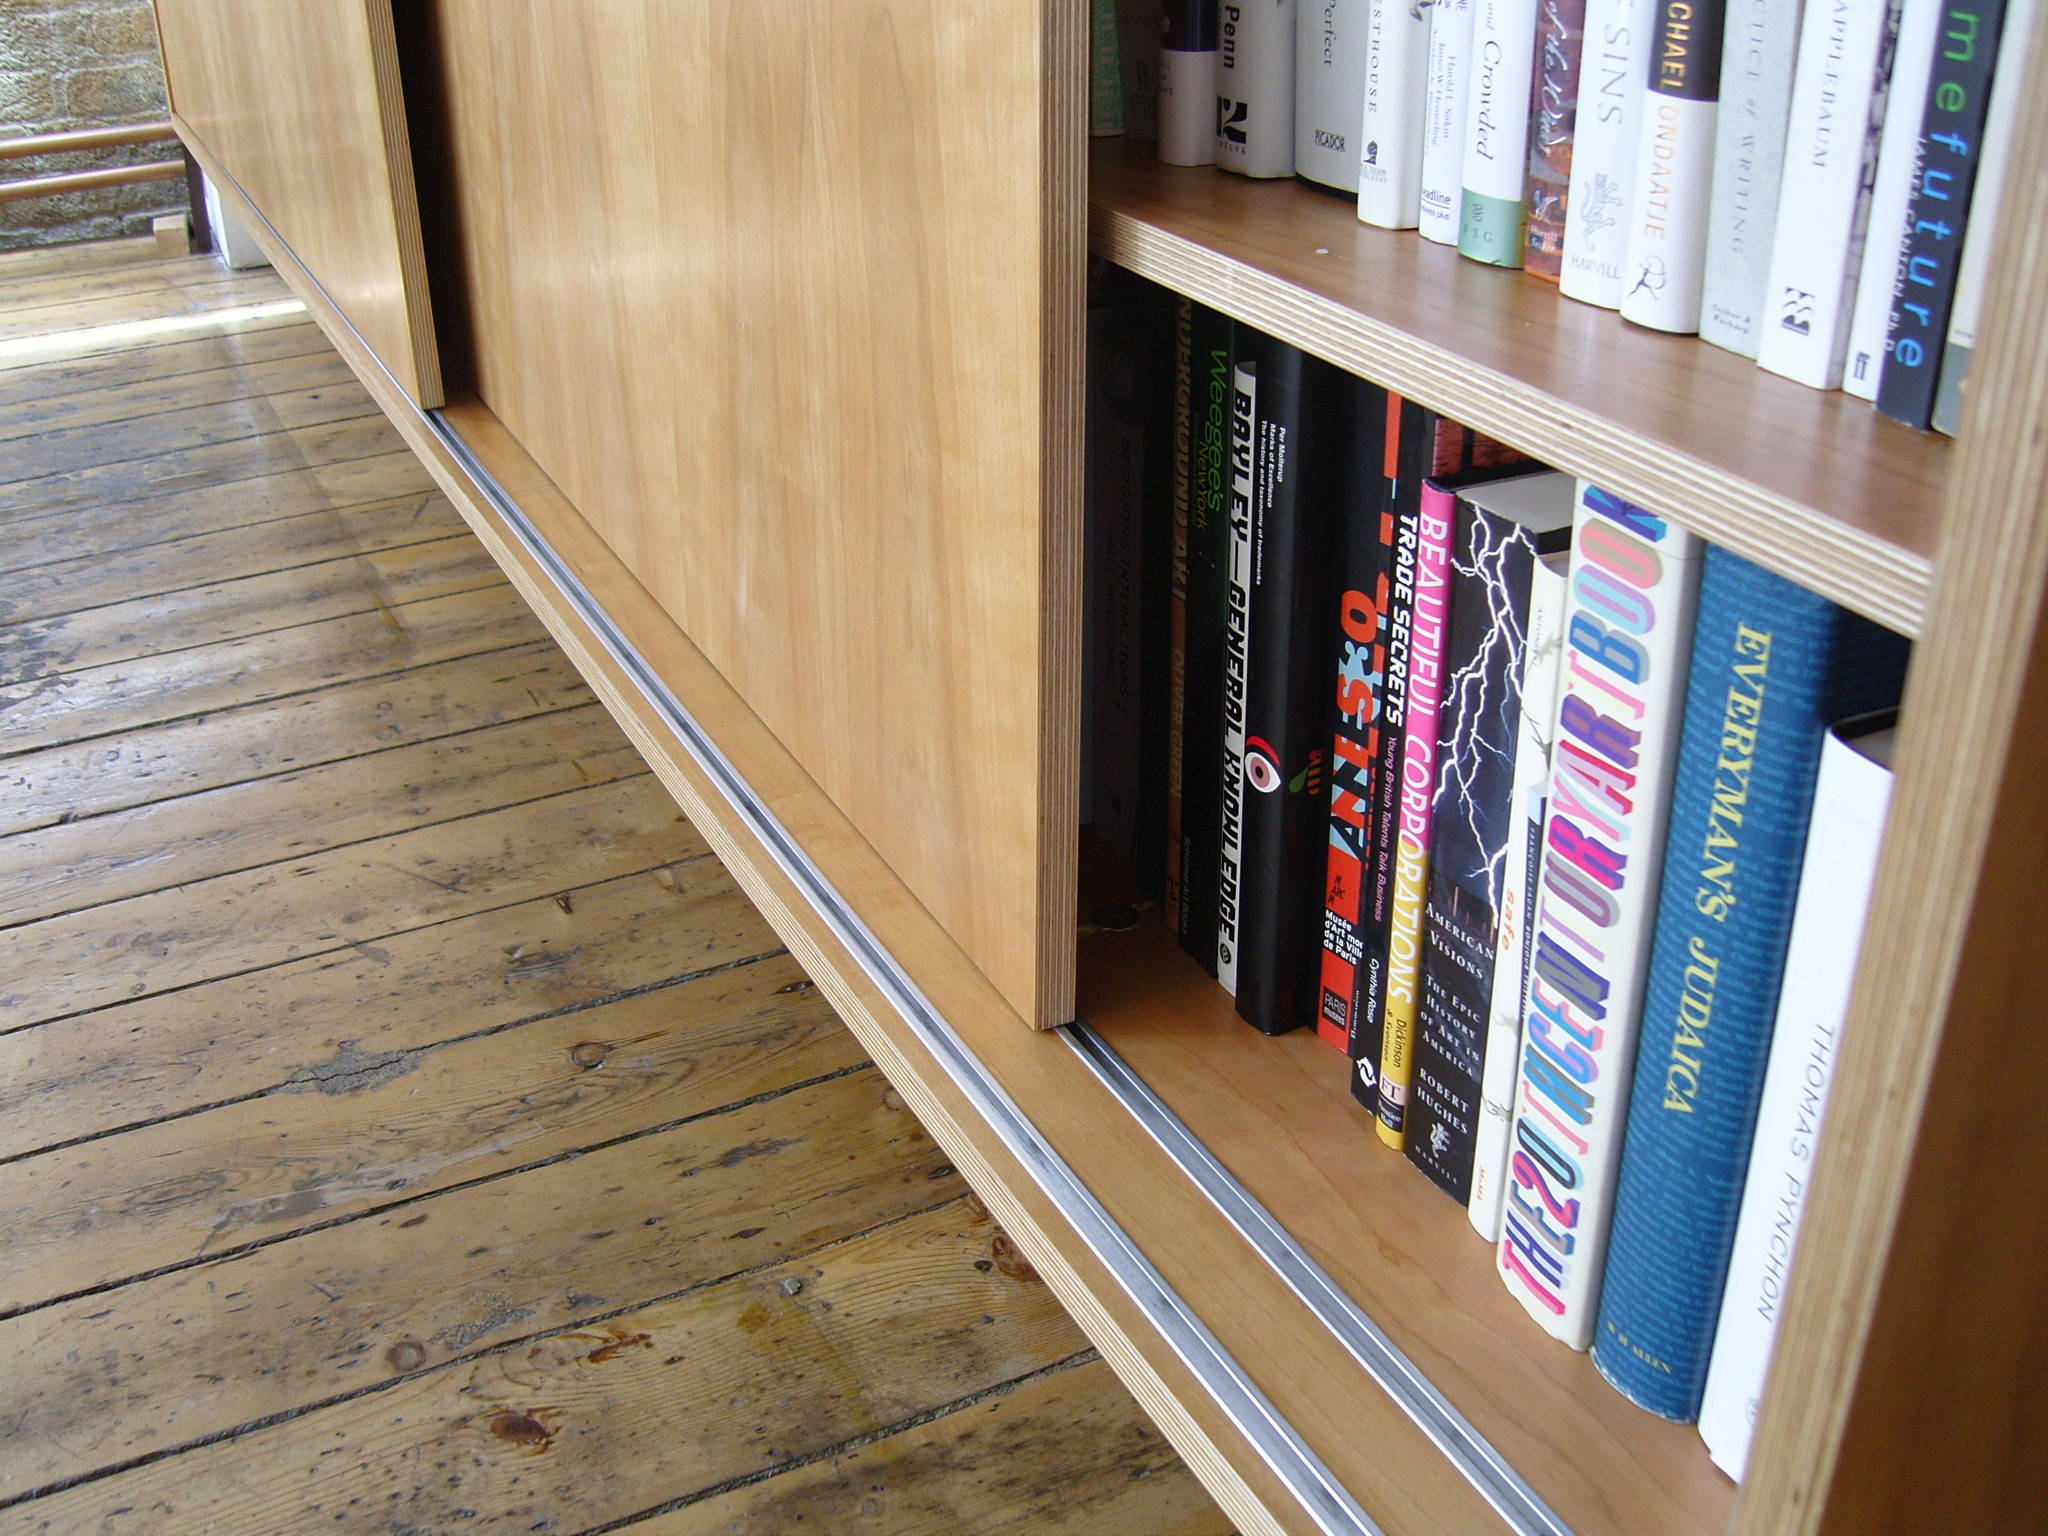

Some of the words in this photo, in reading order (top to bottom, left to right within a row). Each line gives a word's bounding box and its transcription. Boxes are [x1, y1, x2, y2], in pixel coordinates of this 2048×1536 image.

[1222, 5, 1241, 70] Penn
[1369, 0, 1383, 113] ESTHOUSE
[1659, 2, 1694, 91] CHAEL
[1597, 24, 1632, 125] SINS
[1475, 40, 1502, 161] Crowded
[1315, 129, 1346, 152] PICADOR
[1644, 104, 1680, 240] ONDAATJE
[1731, 134, 1755, 254] WRITING
[1570, 253, 1621, 280] HARVILL
[1174, 297, 1192, 530] NDERGROUND
[1269, 423, 1277, 451] Marks
[1266, 462, 1275, 509] Excellence
[1394, 513, 1418, 605] TRADE
[1406, 511, 1449, 717] BEAUTIFUL
[1385, 605, 1411, 728] SECRETS
[1383, 735, 1398, 765] Young
[1695, 621, 1773, 924] EVERYMAN'S
[1381, 767, 1396, 809] British
[1218, 755, 1243, 944] KNOWLEDGE
[1379, 809, 1393, 849] Talents
[1377, 850, 1389, 873] Talk
[1387, 734, 1433, 1005] CORPORATIONS
[1374, 872, 1387, 922] Business
[1501, 887, 1516, 951] safe
[1335, 945, 1357, 966] Paris
[1425, 901, 1495, 961] AMERICAN
[1429, 929, 1485, 980] VISIONS
[1368, 957, 1380, 996] Cynthia
[1324, 992, 1347, 1016] PARIS
[1366, 996, 1377, 1024] Rose
[1425, 994, 1477, 1041] HISTORY
[1662, 935, 1720, 1114] JUDAICA
[1393, 1018, 1407, 1068] Dickinson
[1422, 1029, 1474, 1078] AMERICA
[1381, 1079, 1401, 1099] FT
[1416, 1086, 1469, 1136] HUGHES
[1419, 1066, 1471, 1115] ROBERT
[1789, 1022, 1836, 1162] THOMAS
[1414, 1144, 1459, 1187] HARVILL
[1756, 1171, 1803, 1323] PYNCHON
